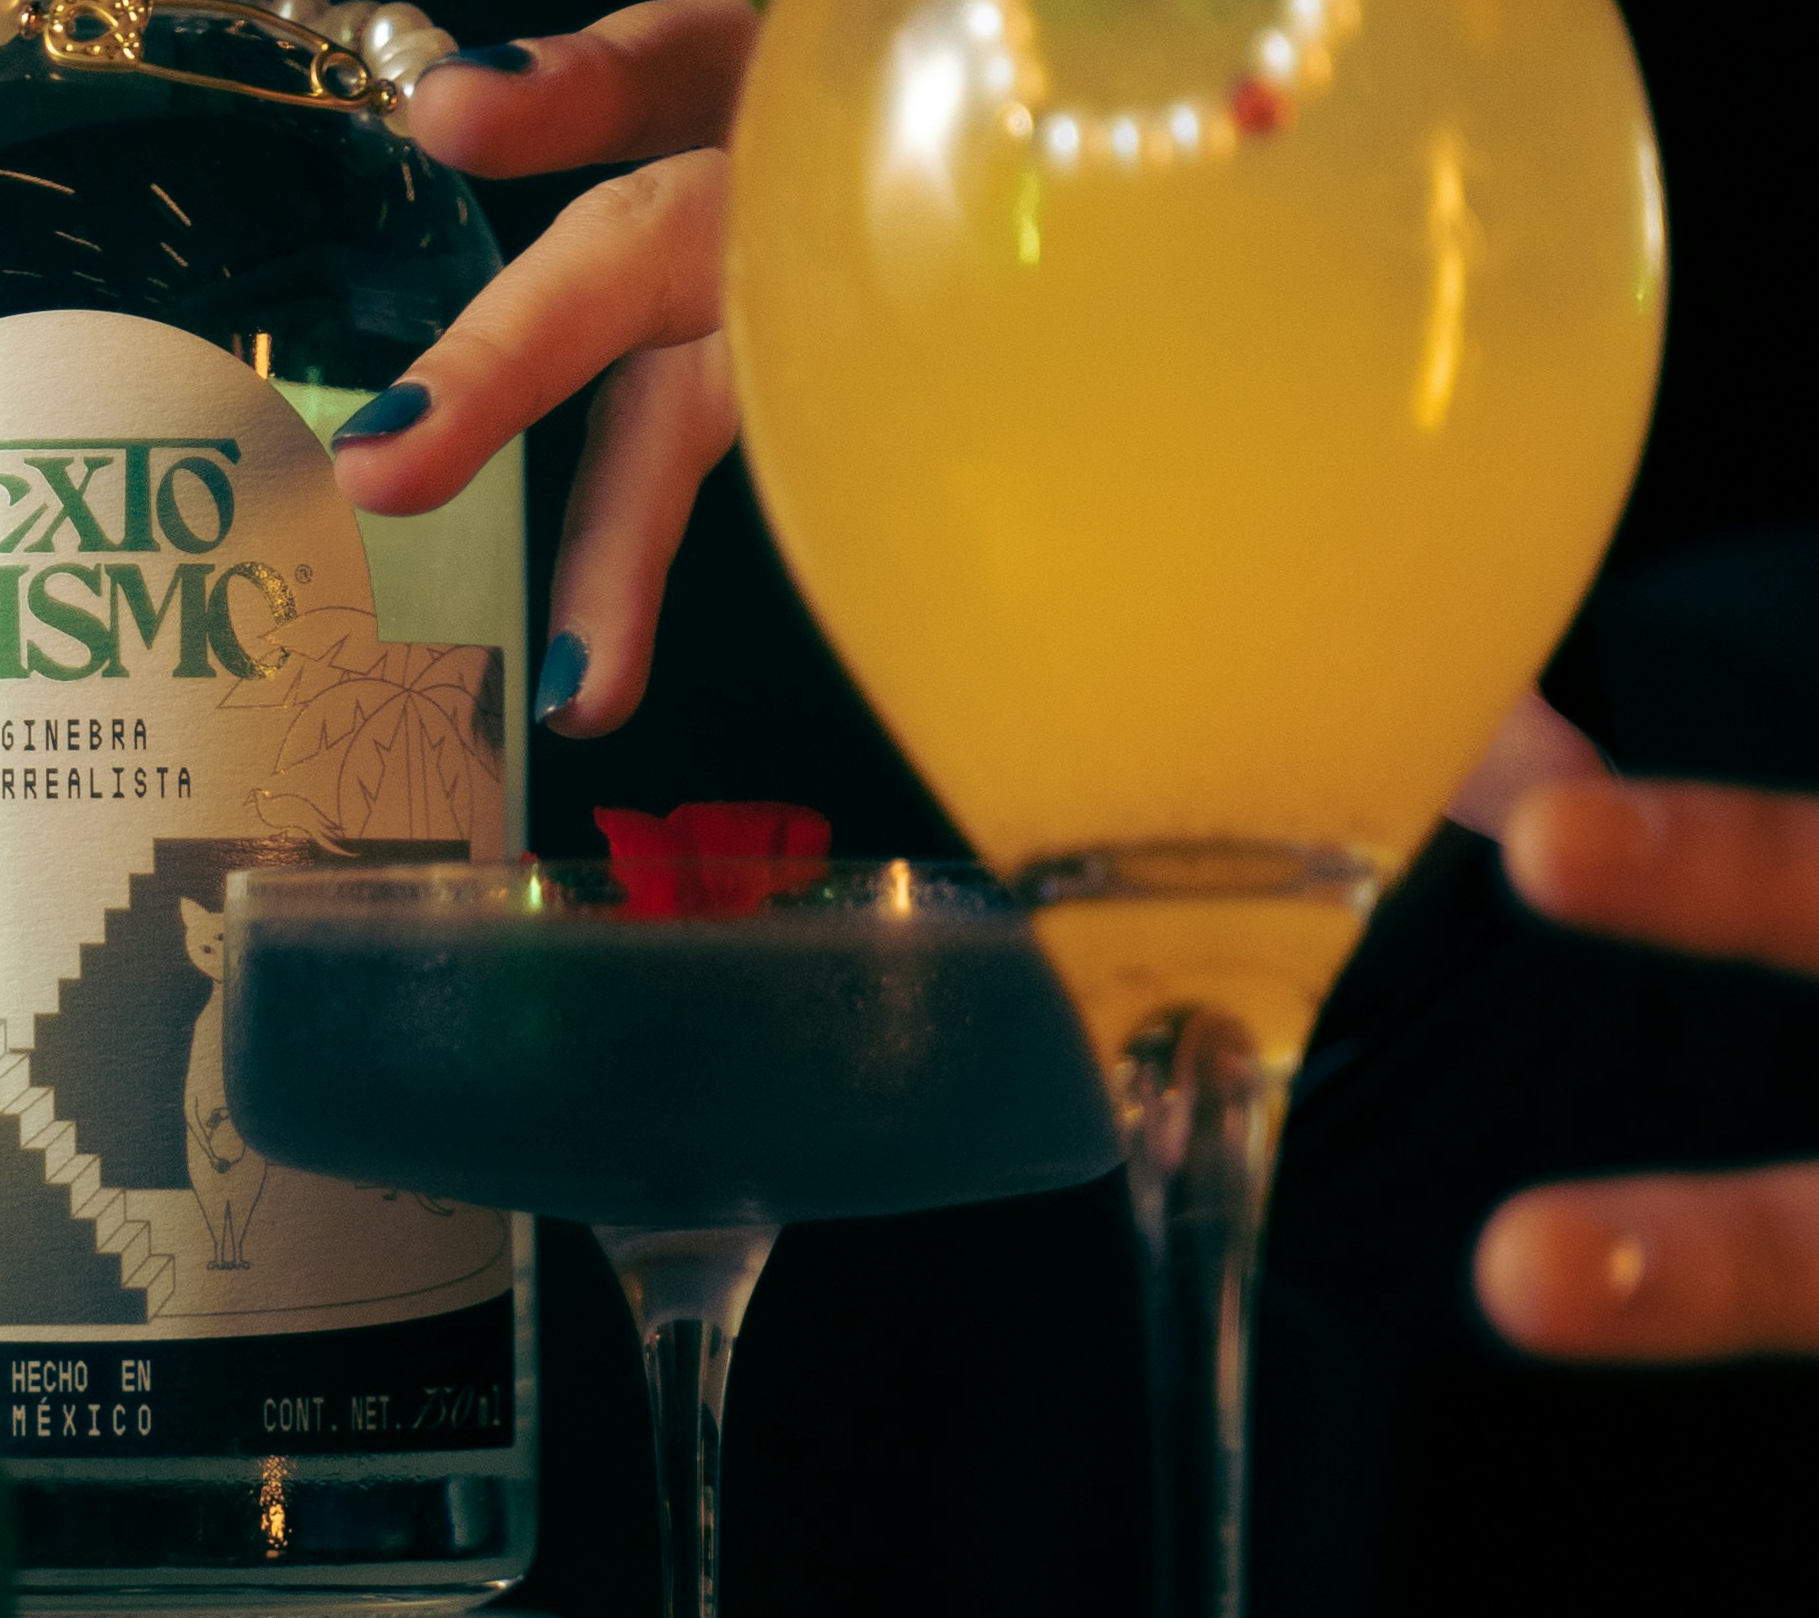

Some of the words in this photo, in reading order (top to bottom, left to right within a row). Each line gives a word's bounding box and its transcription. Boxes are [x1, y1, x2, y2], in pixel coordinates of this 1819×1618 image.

[0, 718, 148, 752] GINEBRA
[11, 1359, 89, 1394] HECHO
[121, 1359, 152, 1394] EN
[11, 1396, 154, 1439] MÉXICO
[263, 1396, 339, 1434] CONT.
[349, 1394, 403, 1432] NET.
